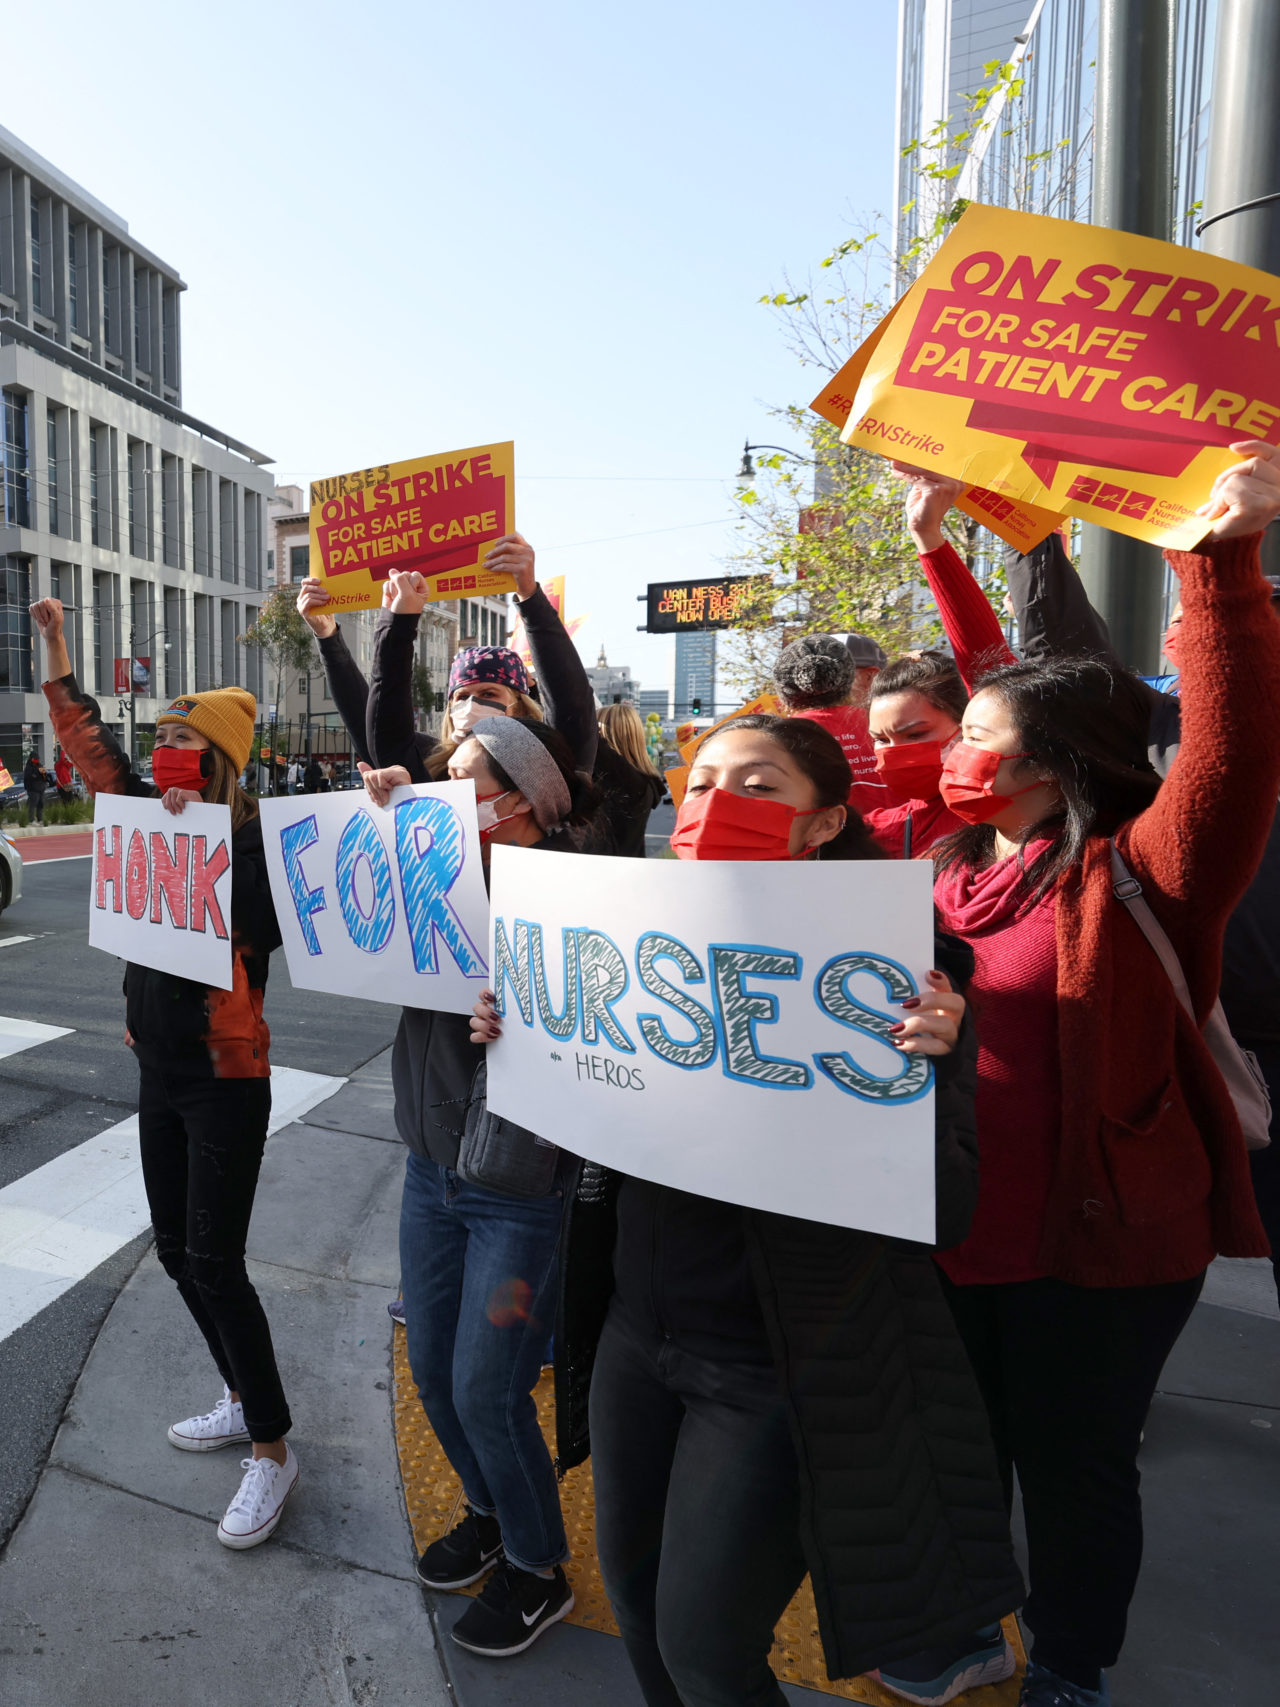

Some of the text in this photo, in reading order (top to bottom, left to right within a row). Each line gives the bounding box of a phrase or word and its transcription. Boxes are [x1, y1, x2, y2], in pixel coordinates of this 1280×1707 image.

[950, 250, 1280, 348] ON STRIK
[931, 305, 1147, 363] FOR SAFE
[908, 341, 1280, 439] PATIENT CARE
[310, 464, 391, 506] NURSES
[321, 453, 494, 525] ON STRIKE
[327, 507, 422, 547] FOR SAFE
[329, 509, 498, 569] PATIENT CARE
[658, 598, 705, 613] CENTER
[663, 587, 688, 600] VAN
[691, 585, 725, 599] NESS
[676, 610, 704, 623] NOW
[842, 743, 861, 751] ero.
[861, 754, 877, 763] live
[95, 824, 231, 941] HONK
[279, 796, 490, 980] FOR
[493, 916, 936, 1106] NURSES
[575, 1051, 646, 1091] HEROS
